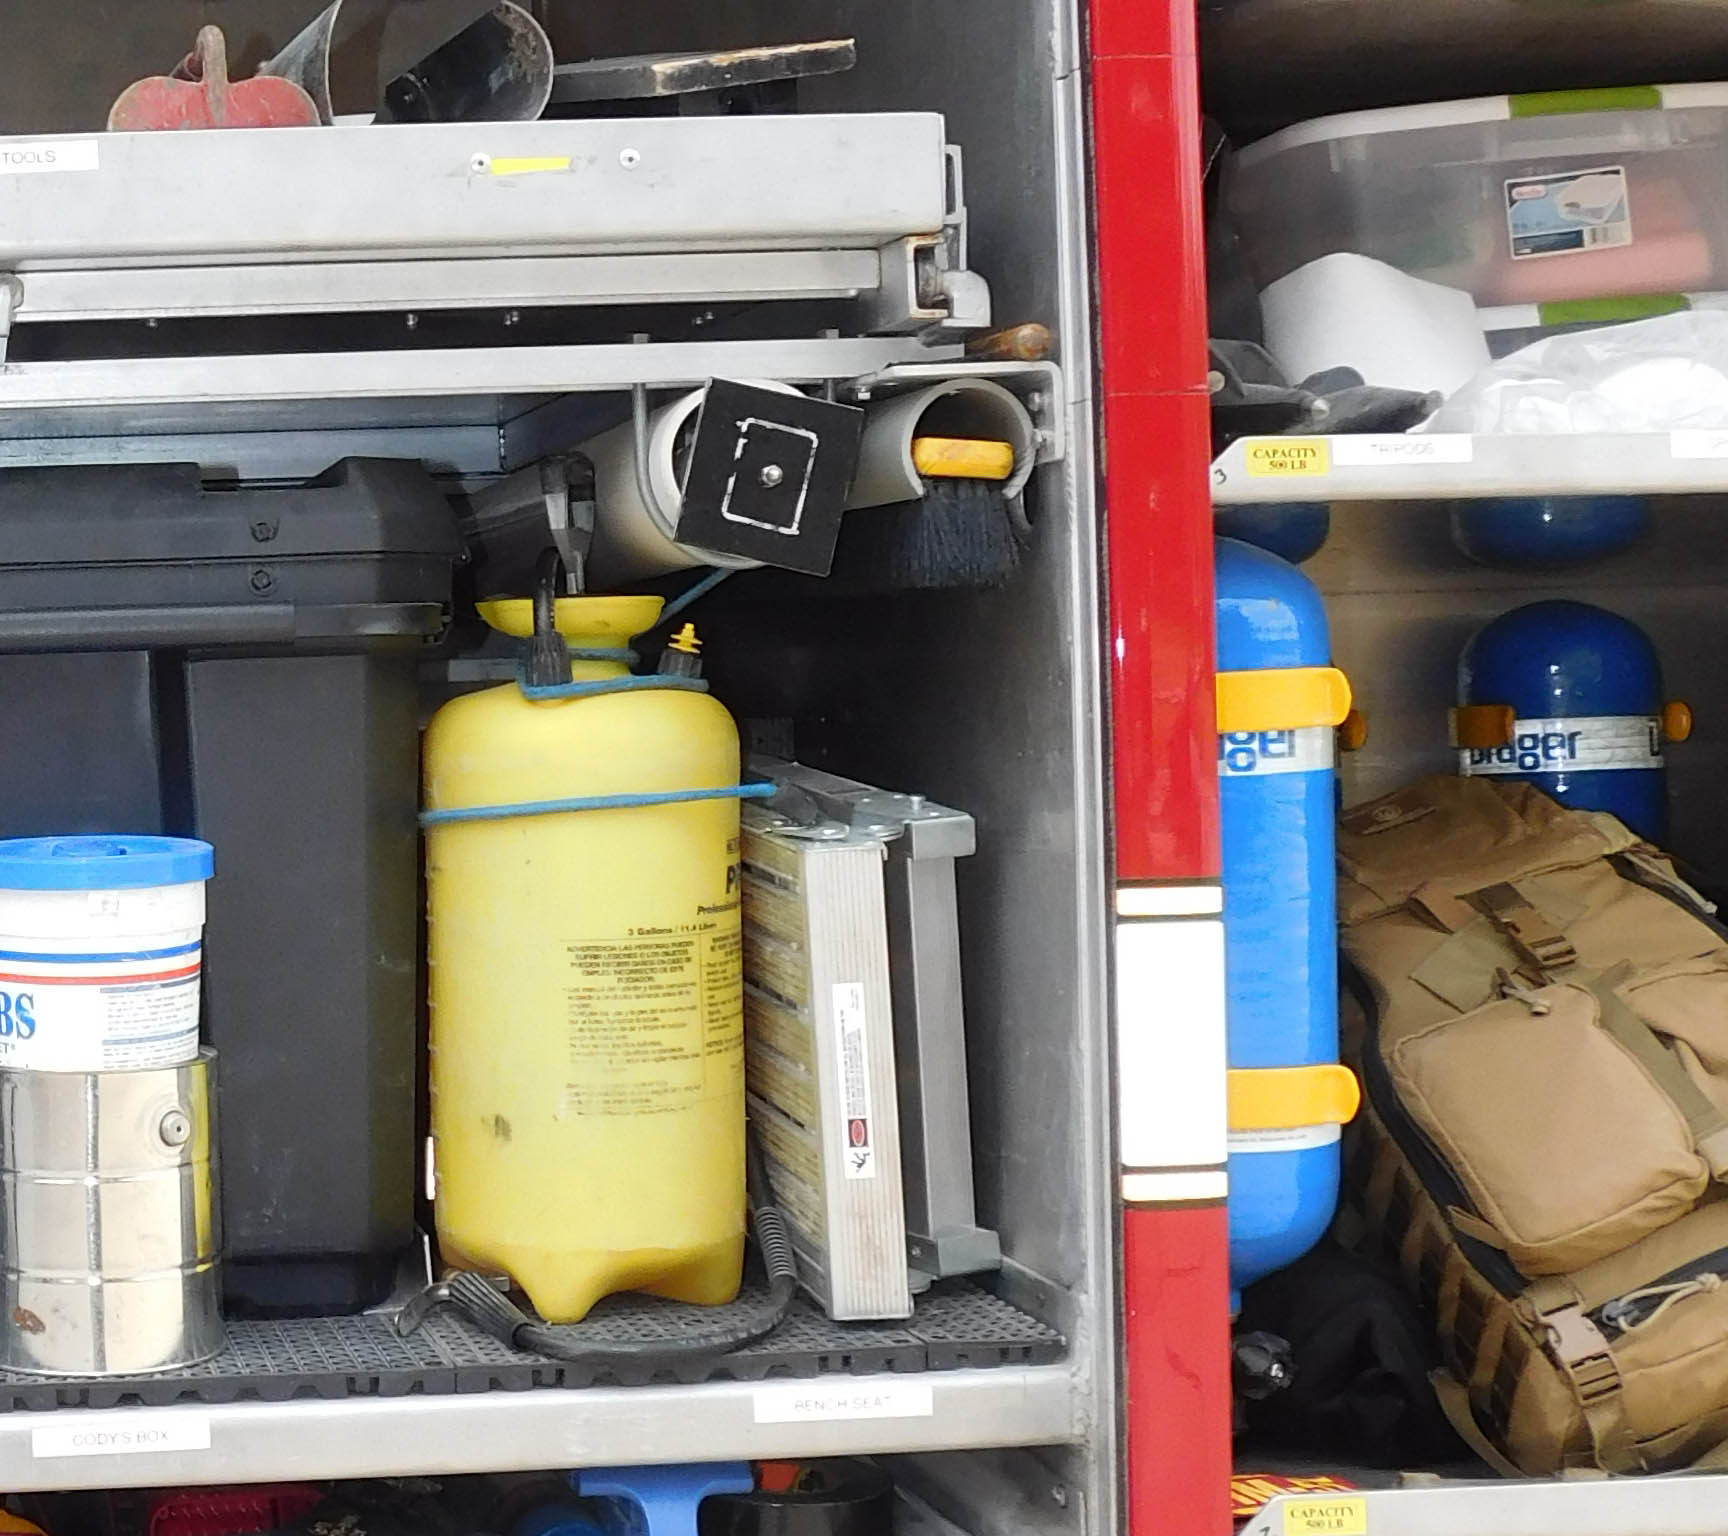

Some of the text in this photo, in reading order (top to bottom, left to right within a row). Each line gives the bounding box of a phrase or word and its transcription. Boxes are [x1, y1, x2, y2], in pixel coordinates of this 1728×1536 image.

[3, 149, 57, 164] TOOLS
[1252, 447, 1318, 460] CAPACITY
[1268, 459, 1308, 471] 500 LB
[1213, 467, 1228, 486] 3
[637, 926, 673, 936] Gallons
[794, 1395, 891, 1412] BENCH SEAT
[136, 1430, 169, 1444] BOX
[1290, 1506, 1354, 1519] CAPACITY
[1328, 1519, 1344, 1529] LB
